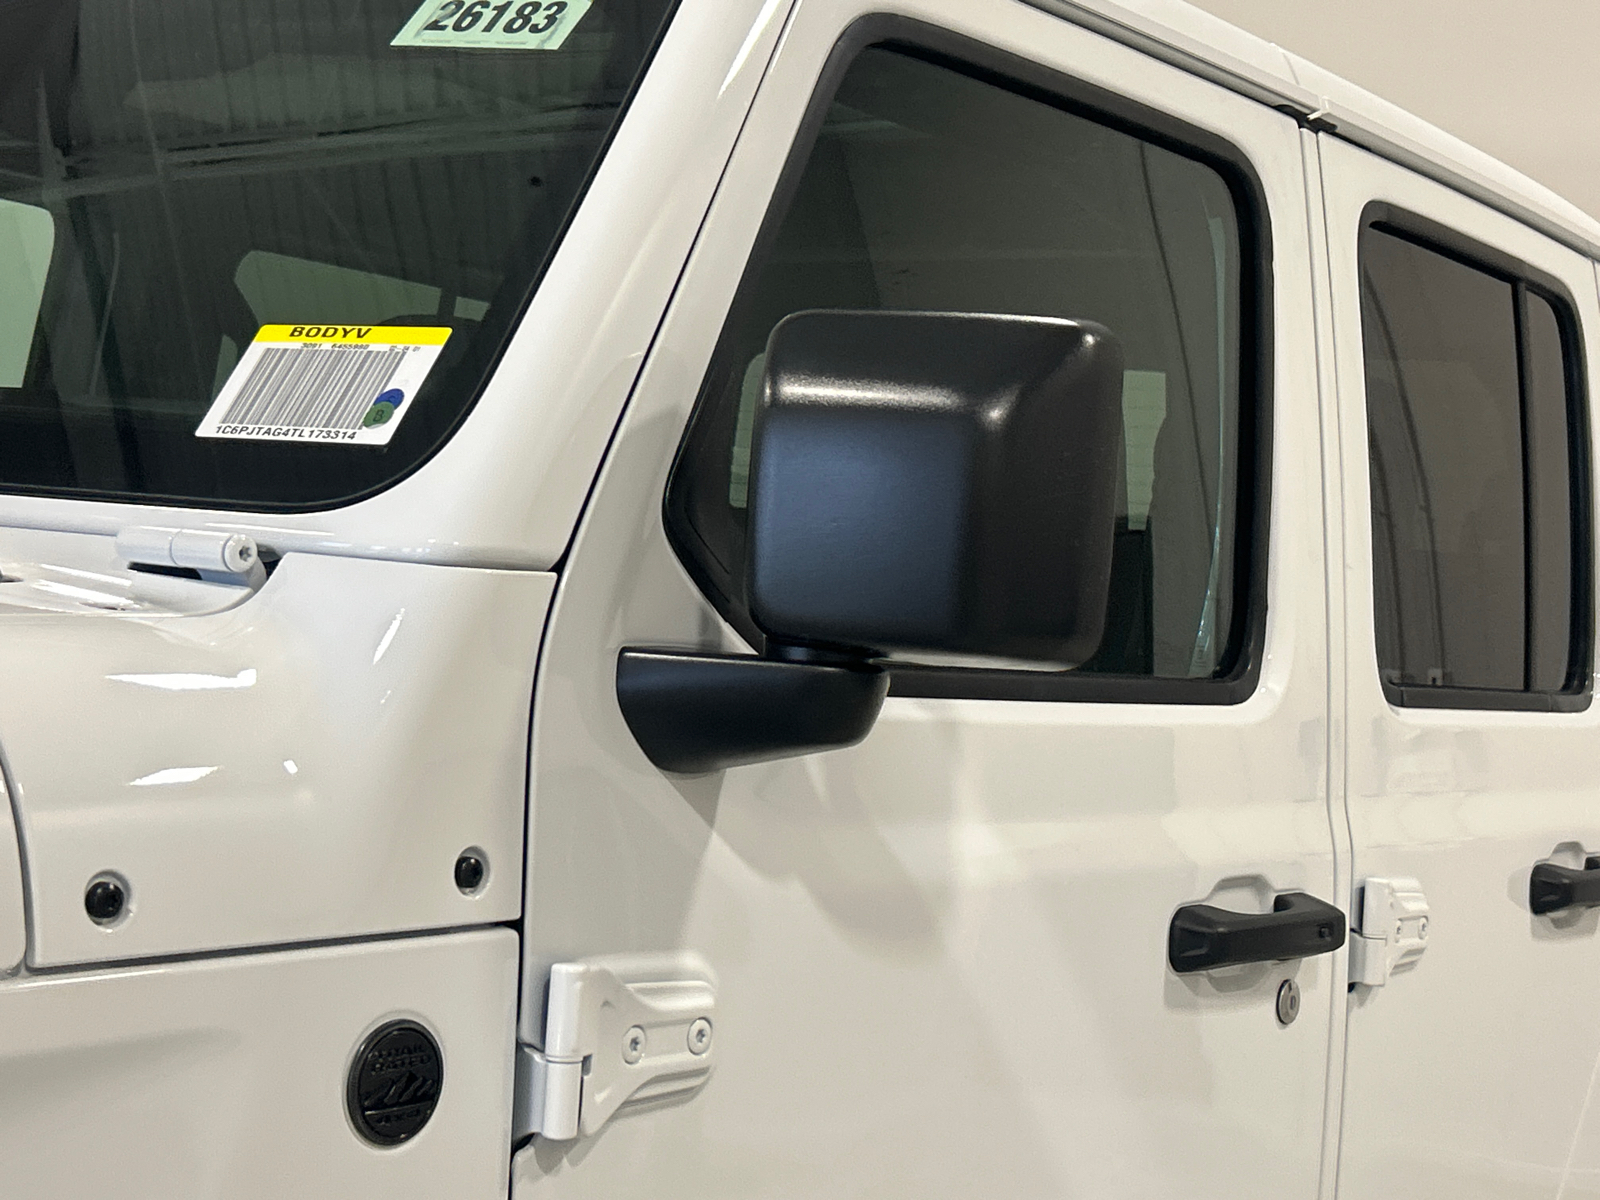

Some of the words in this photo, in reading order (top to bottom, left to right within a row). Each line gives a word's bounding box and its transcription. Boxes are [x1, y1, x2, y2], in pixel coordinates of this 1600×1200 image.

[422, 0, 568, 34] 26183
[289, 326, 372, 338] BODYV
[216, 425, 357, 440] 1C6PJTAG4TL173314
